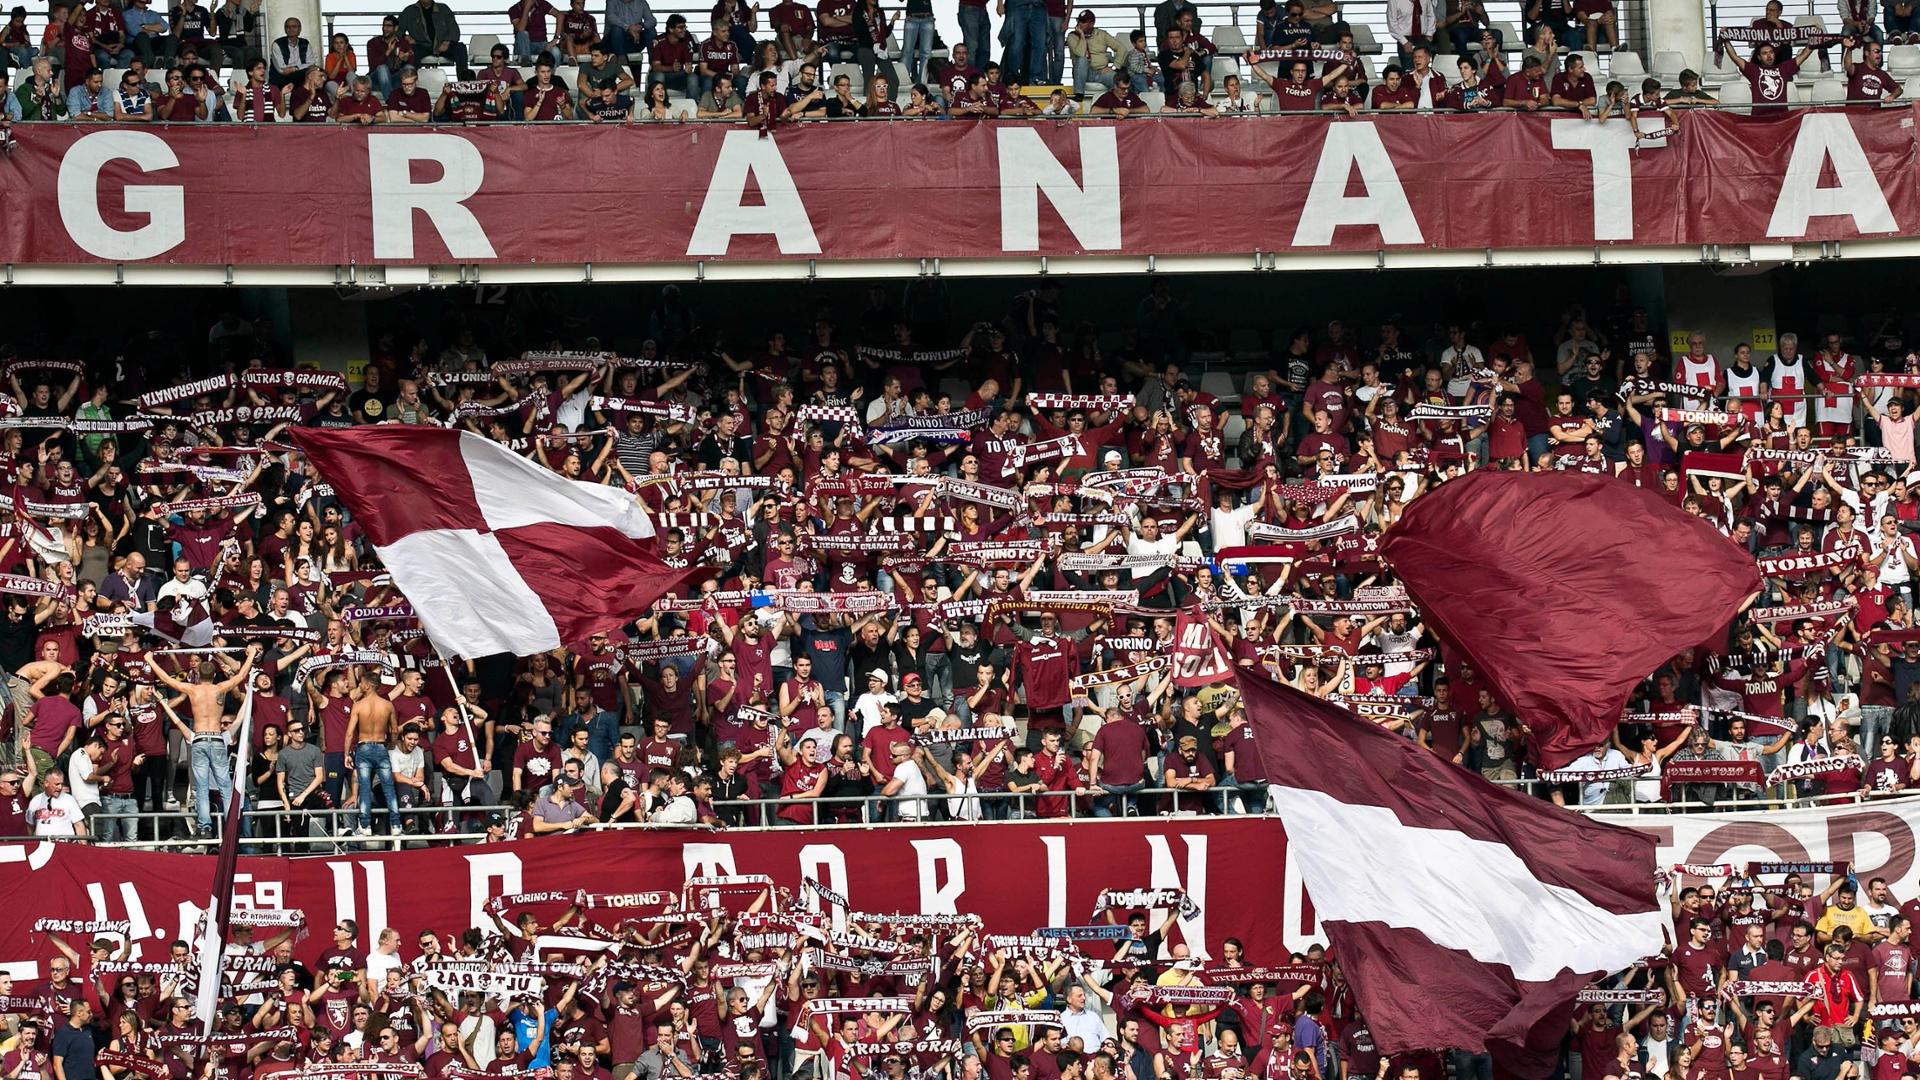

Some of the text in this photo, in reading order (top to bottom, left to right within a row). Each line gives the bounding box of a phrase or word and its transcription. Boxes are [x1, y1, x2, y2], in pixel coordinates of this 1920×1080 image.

[1773, 28, 1797, 41] CLUB
[1260, 49, 1344, 60] JUVE TI ODIO
[1755, 334, 1774, 344] 217
[908, 416, 944, 428] TORINO
[1677, 410, 1729, 424] TORINO
[1755, 449, 1816, 461] TORINO
[695, 476, 771, 489] MCT ULTRAS
[948, 482, 1015, 505] FORZA TORO
[1046, 513, 1077, 523] JUVE
[973, 547, 1035, 559] TORINO FC
[1762, 547, 1857, 574] TORINO
[355, 607, 384, 617] ODIO
[387, 607, 405, 616] LA
[1310, 600, 1390, 612] 12 LA MARATONA
[1771, 601, 1842, 617] FORZA TORO
[668, 645, 689, 654] KORPS
[1104, 638, 1153, 651] TORINO
[1744, 680, 1777, 696] TORINO
[930, 730, 946, 744] LA
[947, 727, 1004, 741] MARATONA
[647, 754, 672, 767] Beretta
[1710, 767, 1745, 777] TORO
[1781, 758, 1846, 779] TORINO
[1683, 864, 1724, 877] TORINO
[1761, 865, 1834, 874] DYNAMITE
[510, 891, 564, 905] TORINO FC
[605, 893, 660, 908] TORINO
[1042, 927, 1125, 938] WEST HAM
[432, 963, 443, 972] LA
[825, 957, 931, 973] STYLE JUVENTUS
[1212, 971, 1253, 983] ULTRAS
[233, 979, 279, 992] TORINO
